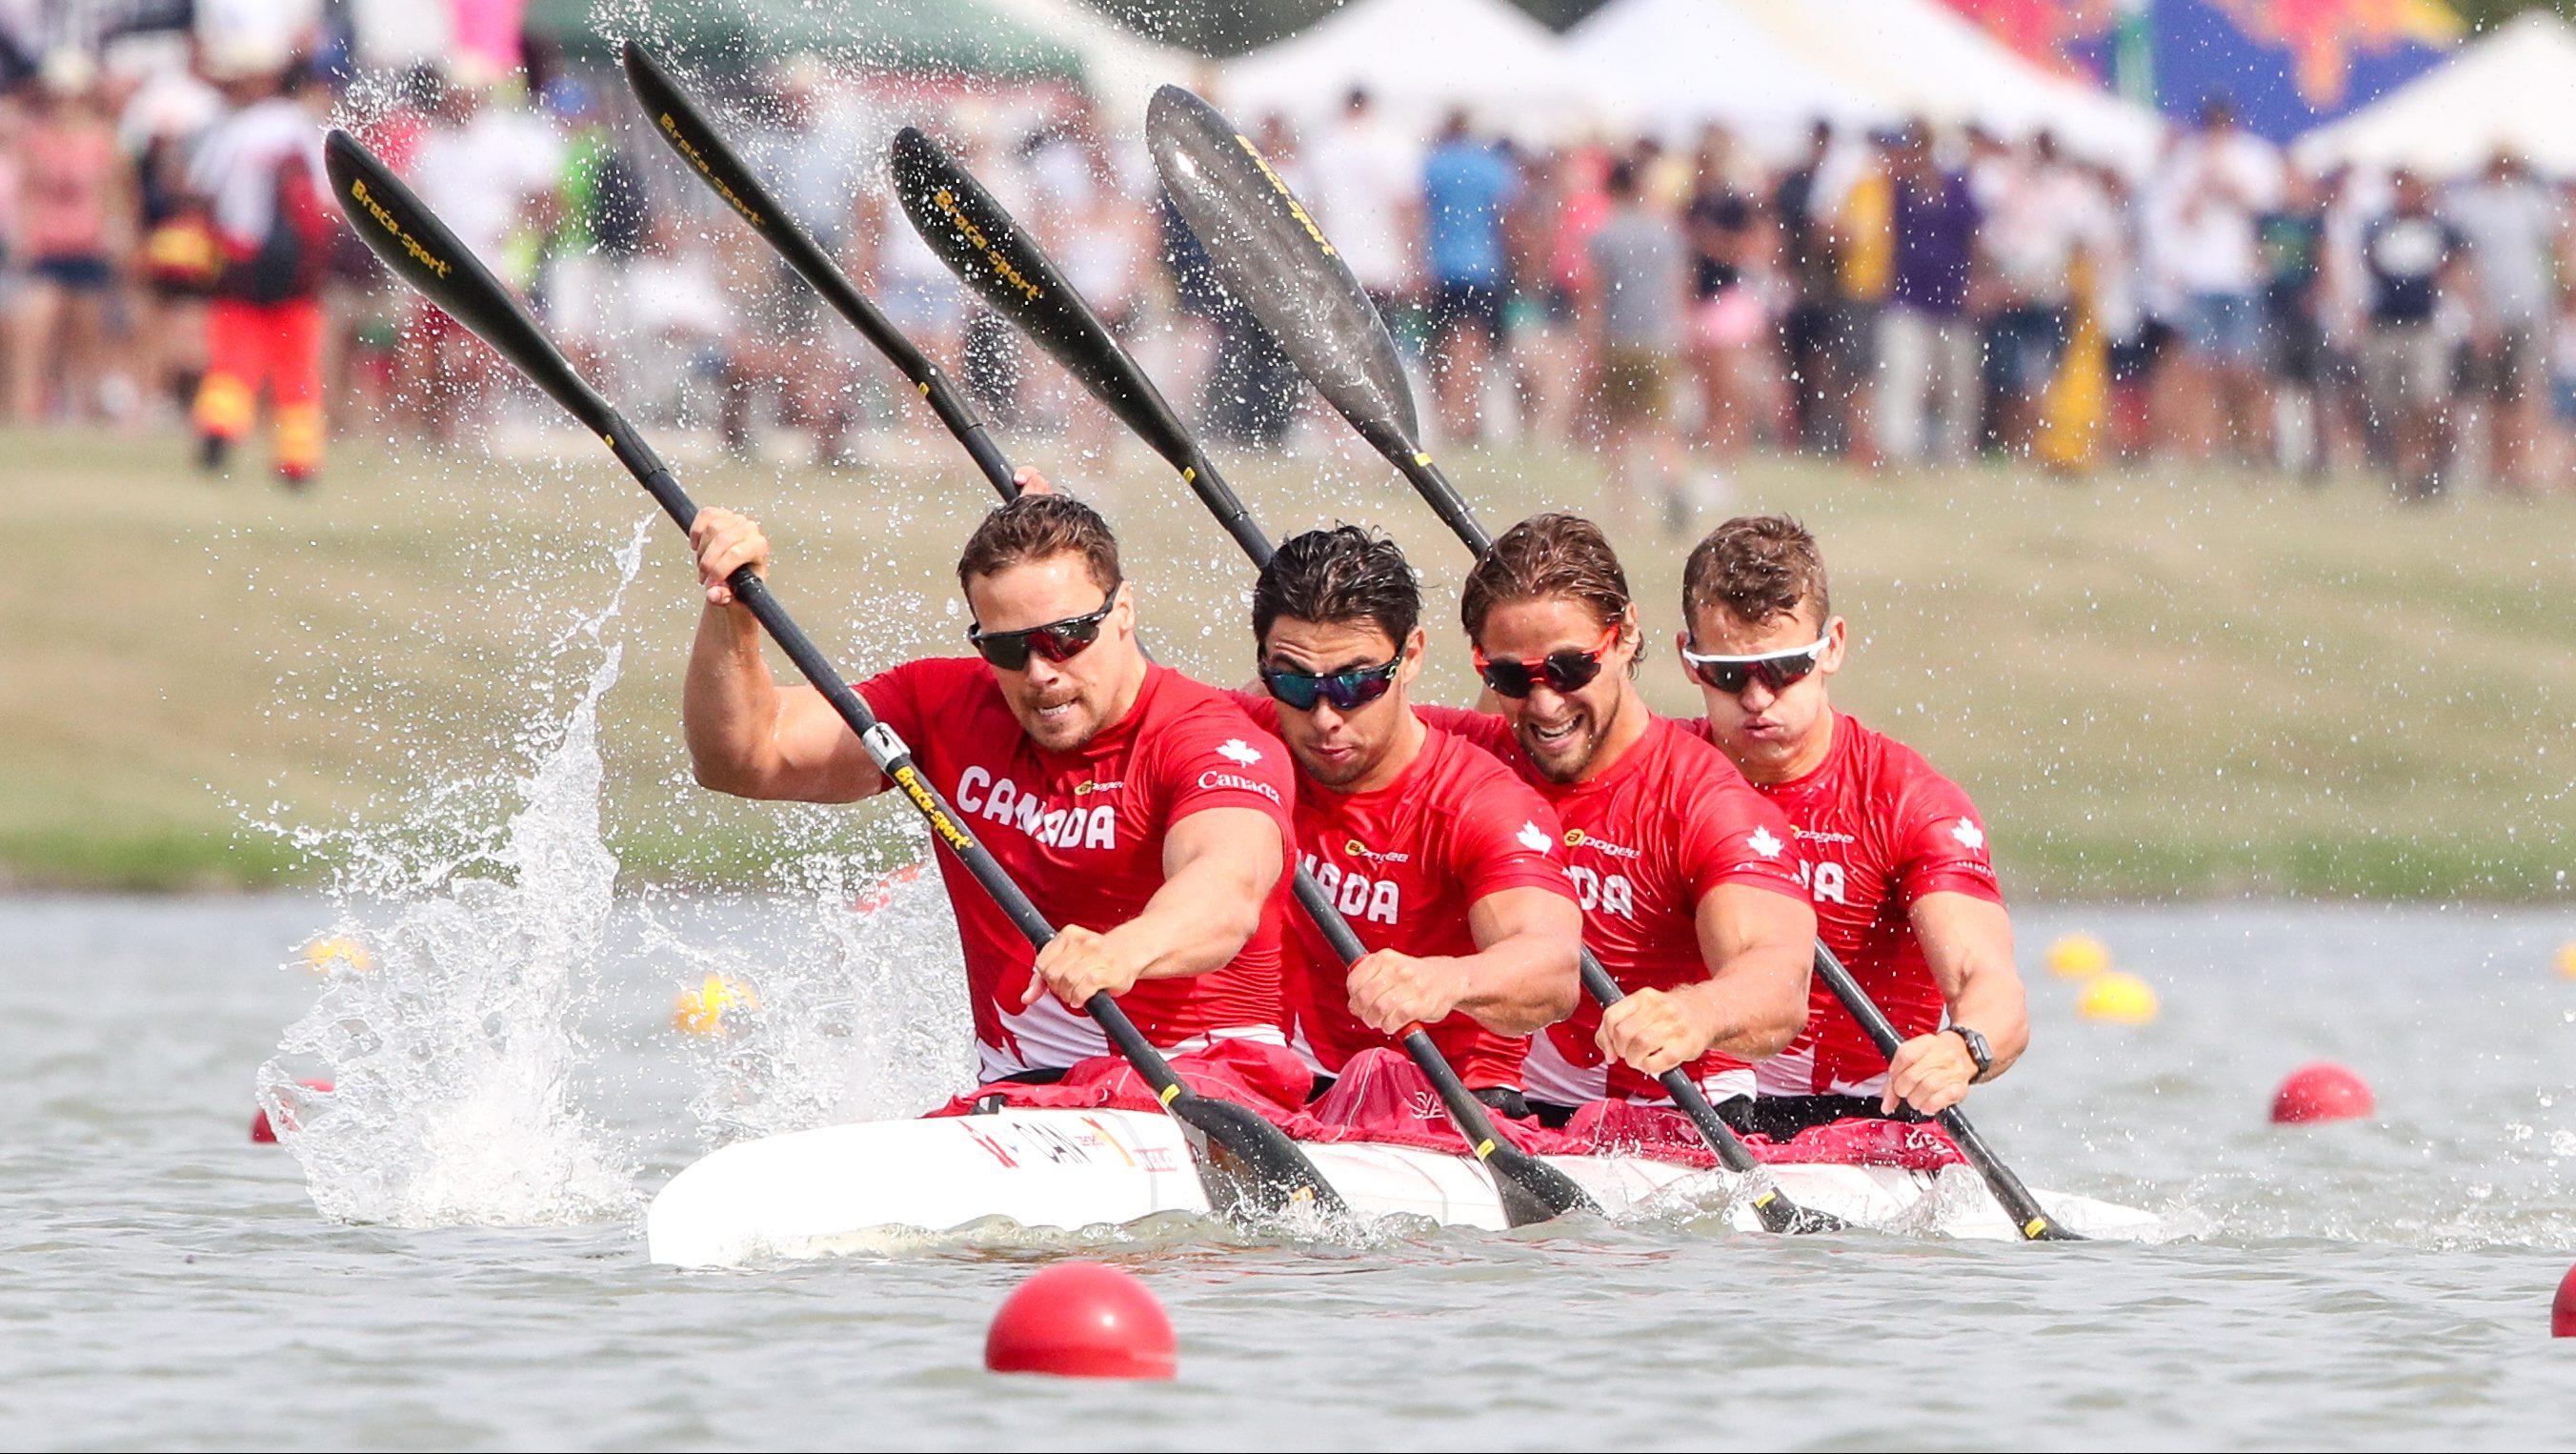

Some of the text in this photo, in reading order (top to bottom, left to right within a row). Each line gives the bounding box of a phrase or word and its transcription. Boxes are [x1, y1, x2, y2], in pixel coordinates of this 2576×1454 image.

[956, 765, 1116, 850] CANADA
[1197, 771, 1281, 806] Canada
[1012, 1121, 1093, 1164] CAN
